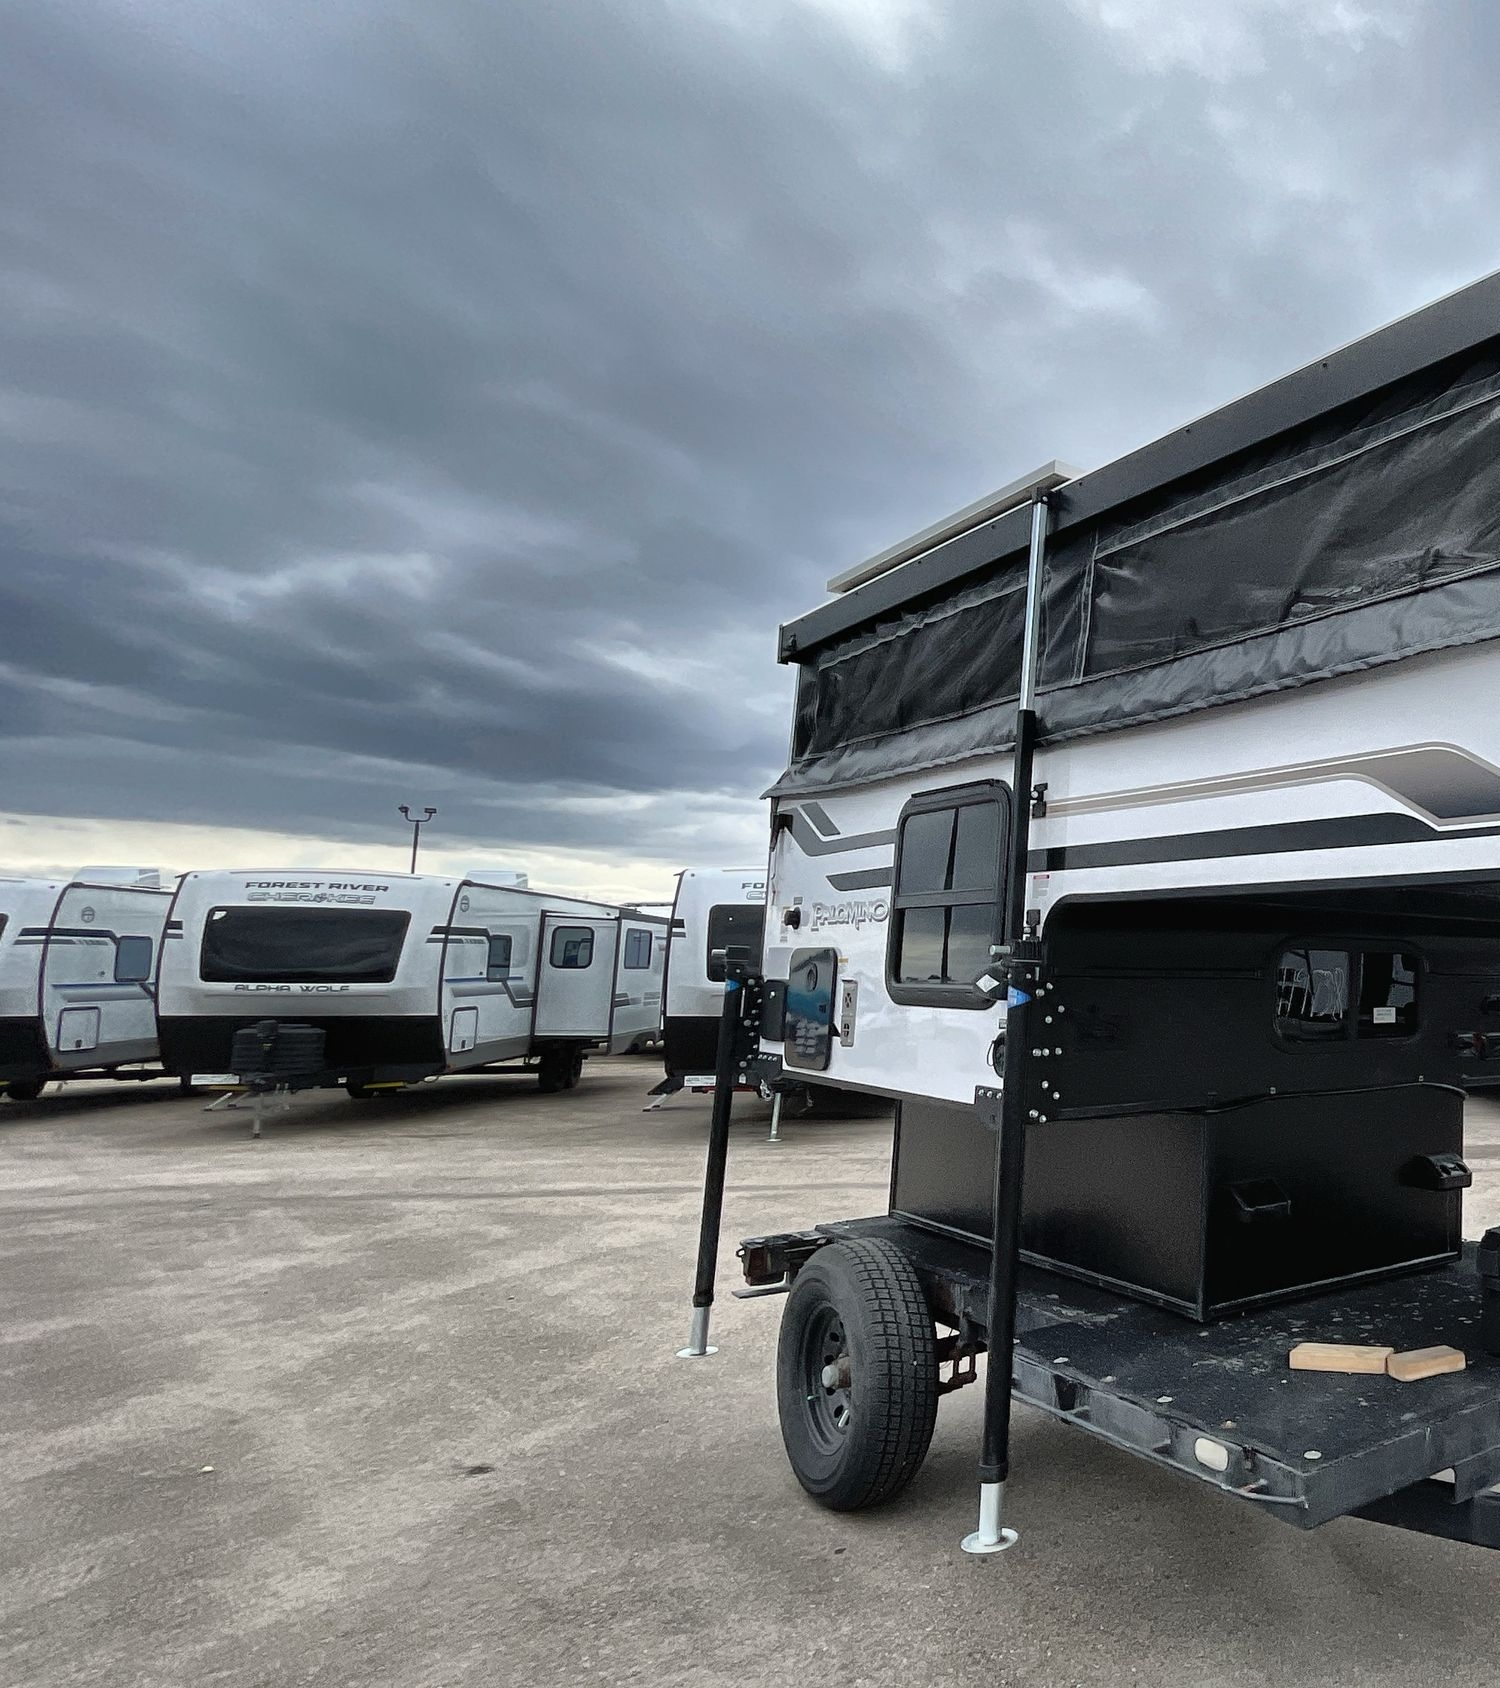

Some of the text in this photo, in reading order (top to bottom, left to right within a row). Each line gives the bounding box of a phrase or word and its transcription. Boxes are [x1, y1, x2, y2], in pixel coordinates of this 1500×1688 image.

[245, 881, 389, 892] FOREST RIVER
[811, 899, 890, 932] PALOMINO
[234, 984, 291, 992] ALPHA
